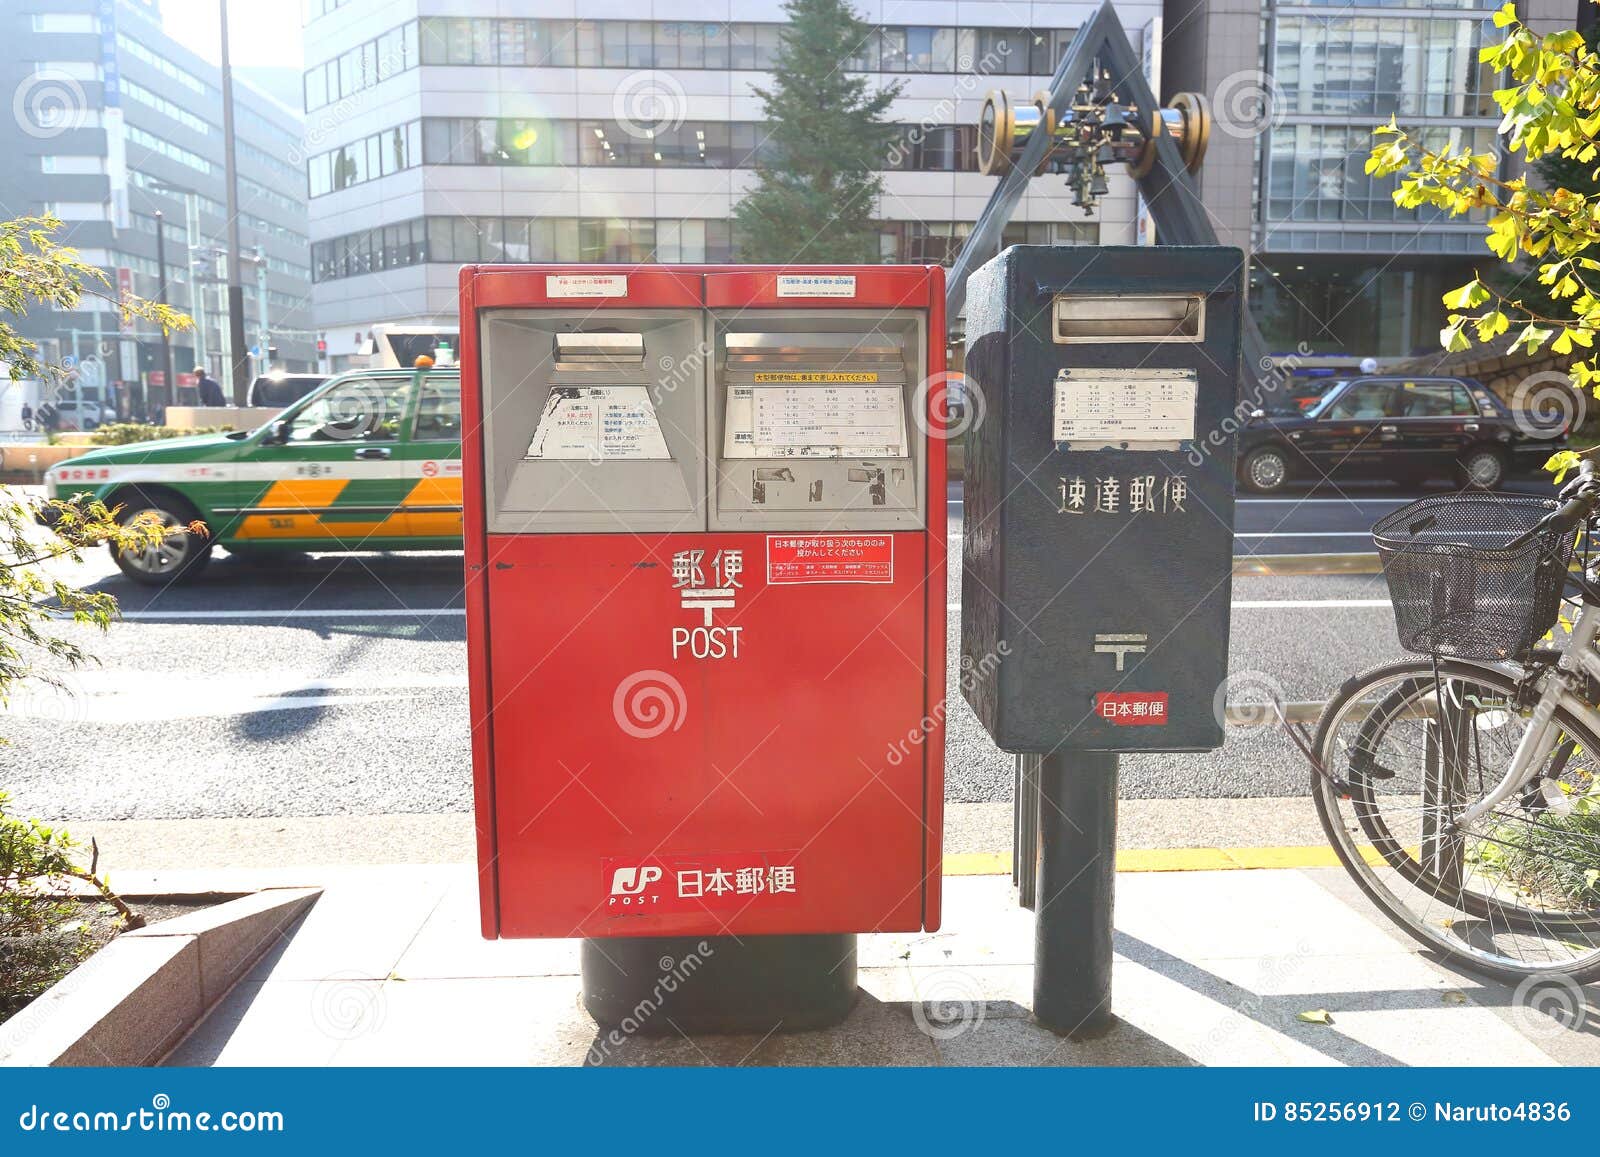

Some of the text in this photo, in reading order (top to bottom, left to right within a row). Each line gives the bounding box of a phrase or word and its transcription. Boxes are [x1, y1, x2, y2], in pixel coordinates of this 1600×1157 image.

[1058, 475, 1187, 514] 速達郵便
[672, 550, 744, 588] 郵便
[672, 627, 743, 660] POST
[1103, 701, 1164, 717] 日本郵便
[677, 866, 796, 898] 日本郵便
[609, 895, 660, 906] POST
